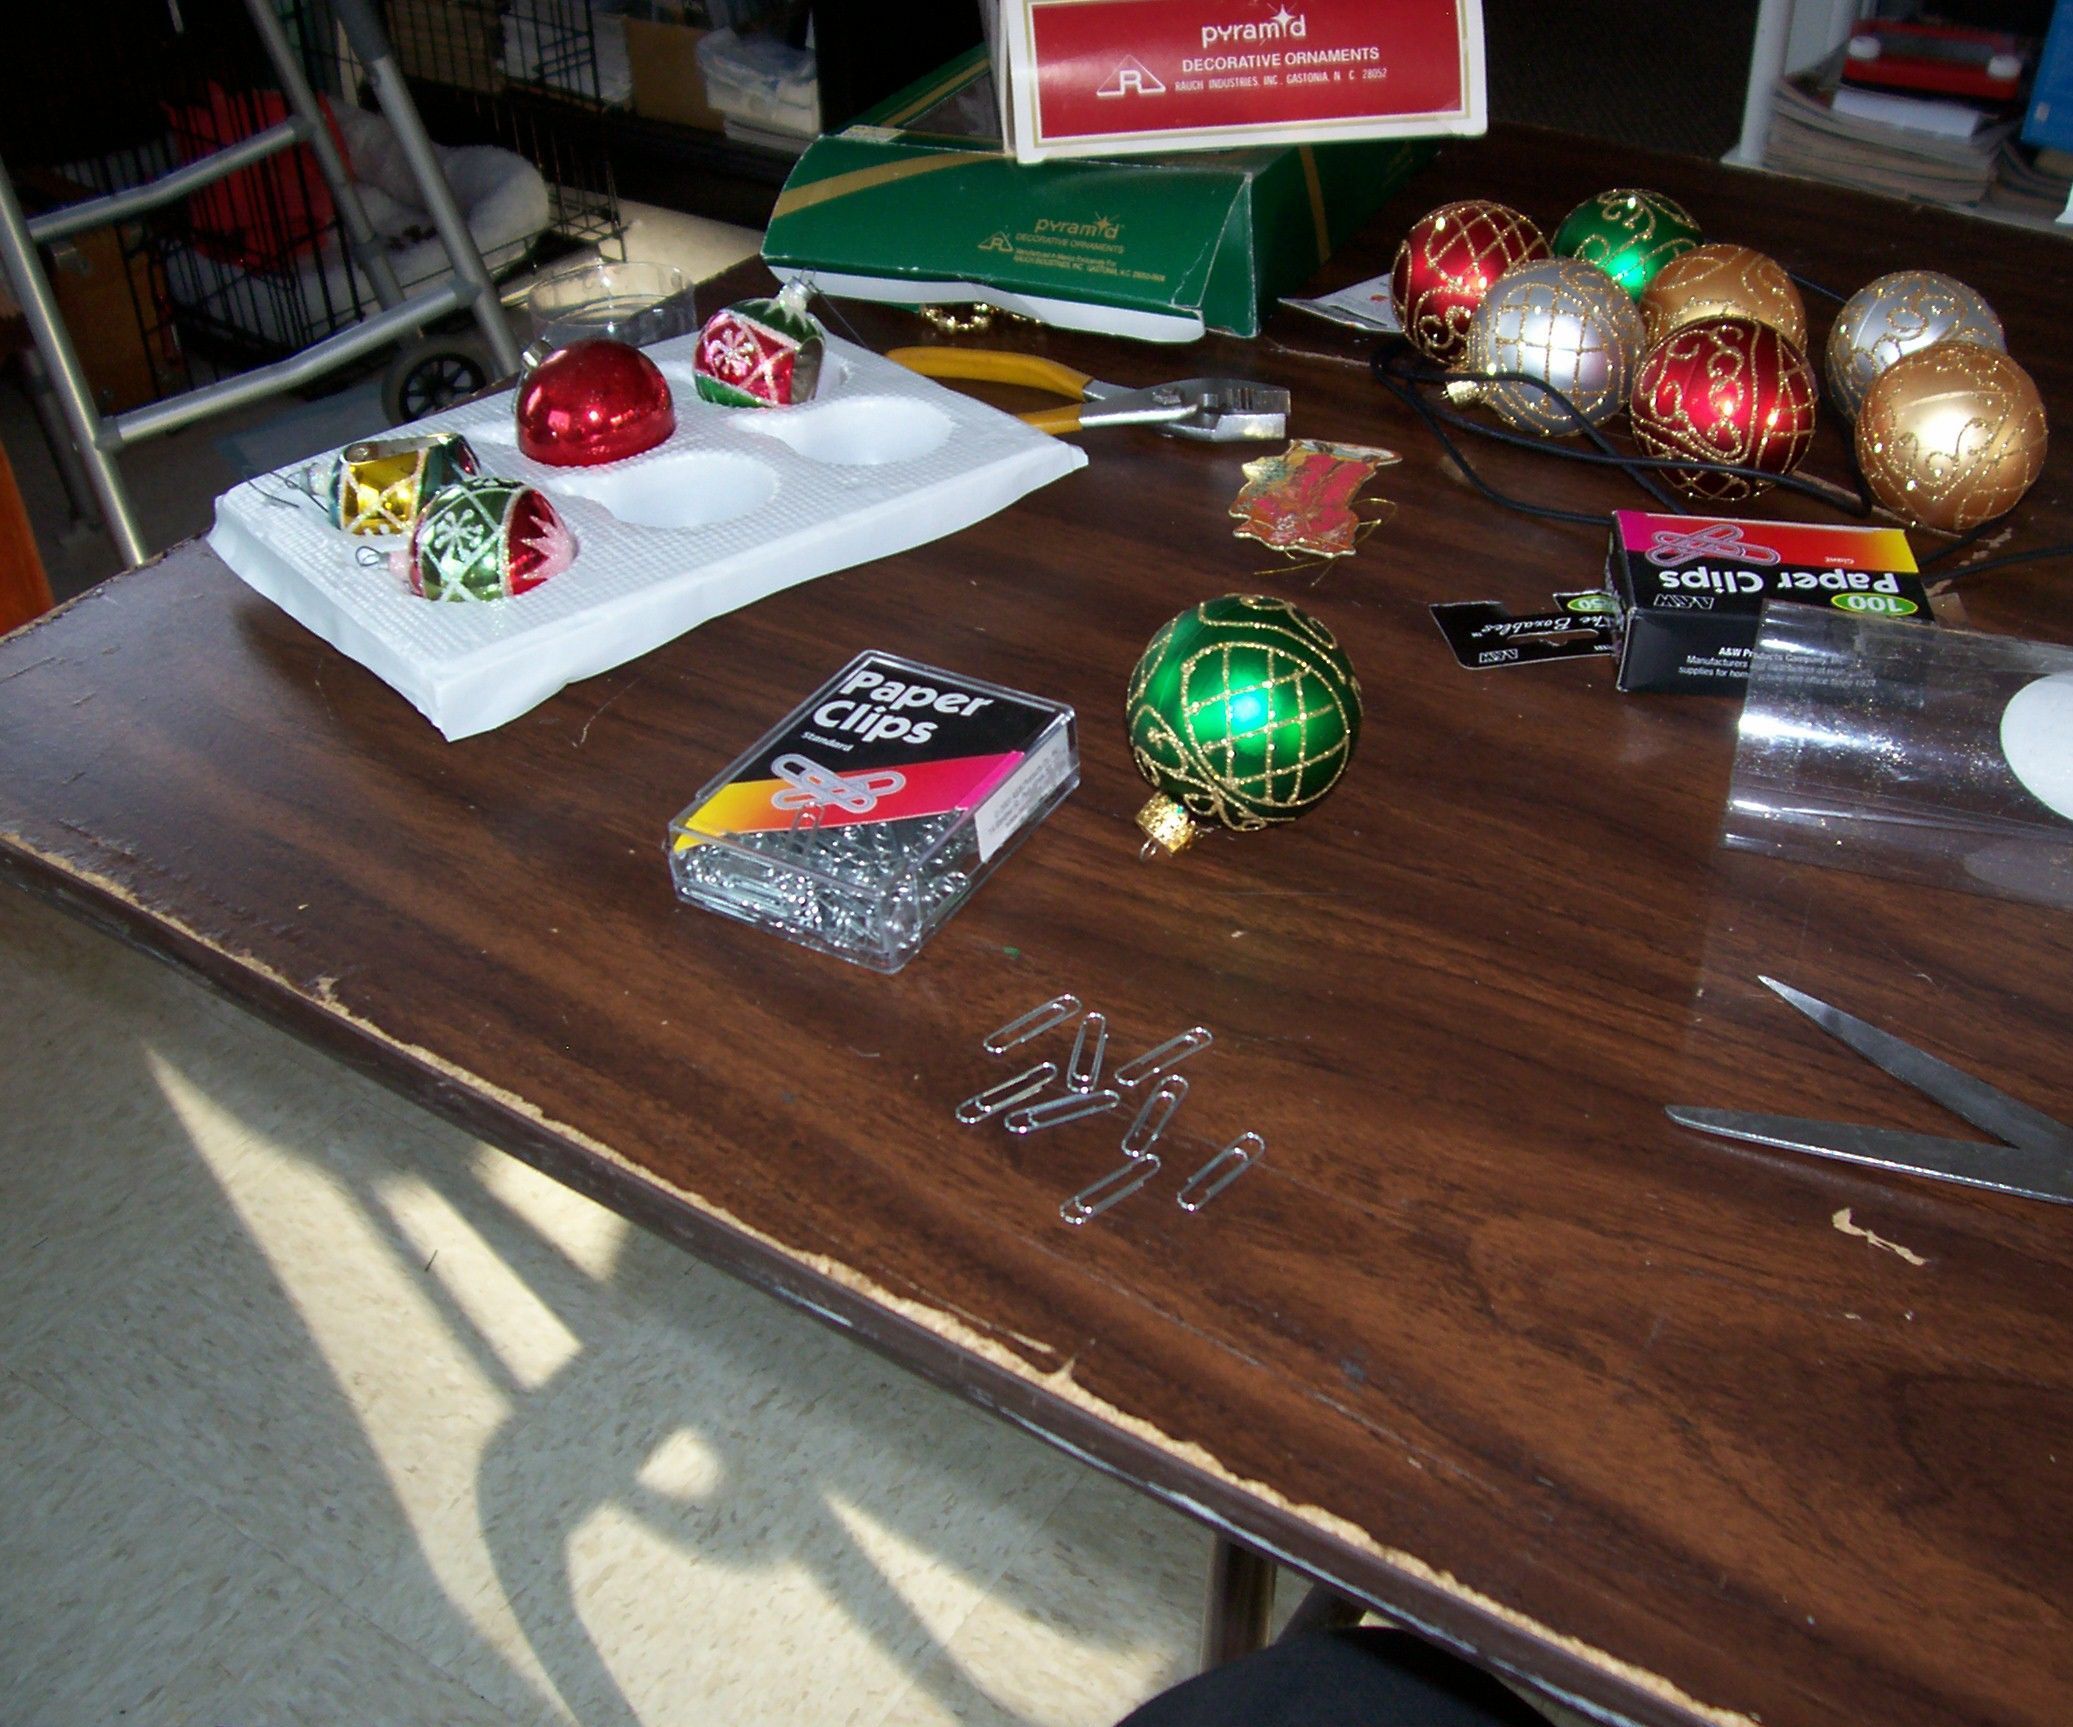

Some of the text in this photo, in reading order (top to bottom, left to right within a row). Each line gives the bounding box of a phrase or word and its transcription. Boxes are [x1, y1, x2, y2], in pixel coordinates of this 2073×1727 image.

[1201, 9, 1307, 48] pyramid
[1182, 46, 1380, 73] DECORATIVE ORNAMENTS
[1174, 79, 1205, 92] RAUCH
[1034, 214, 1120, 239] pyramid
[1658, 566, 1899, 594] Paper Clips
[1847, 594, 1904, 612] 100
[1686, 655, 1749, 668] Manufacturers
[1718, 647, 1742, 656] A&W
[1678, 666, 1714, 676] supplies
[1715, 668, 1728, 676] for
[839, 670, 994, 717] Paper
[812, 700, 938, 744] Clips
[800, 731, 855, 752] Standard
